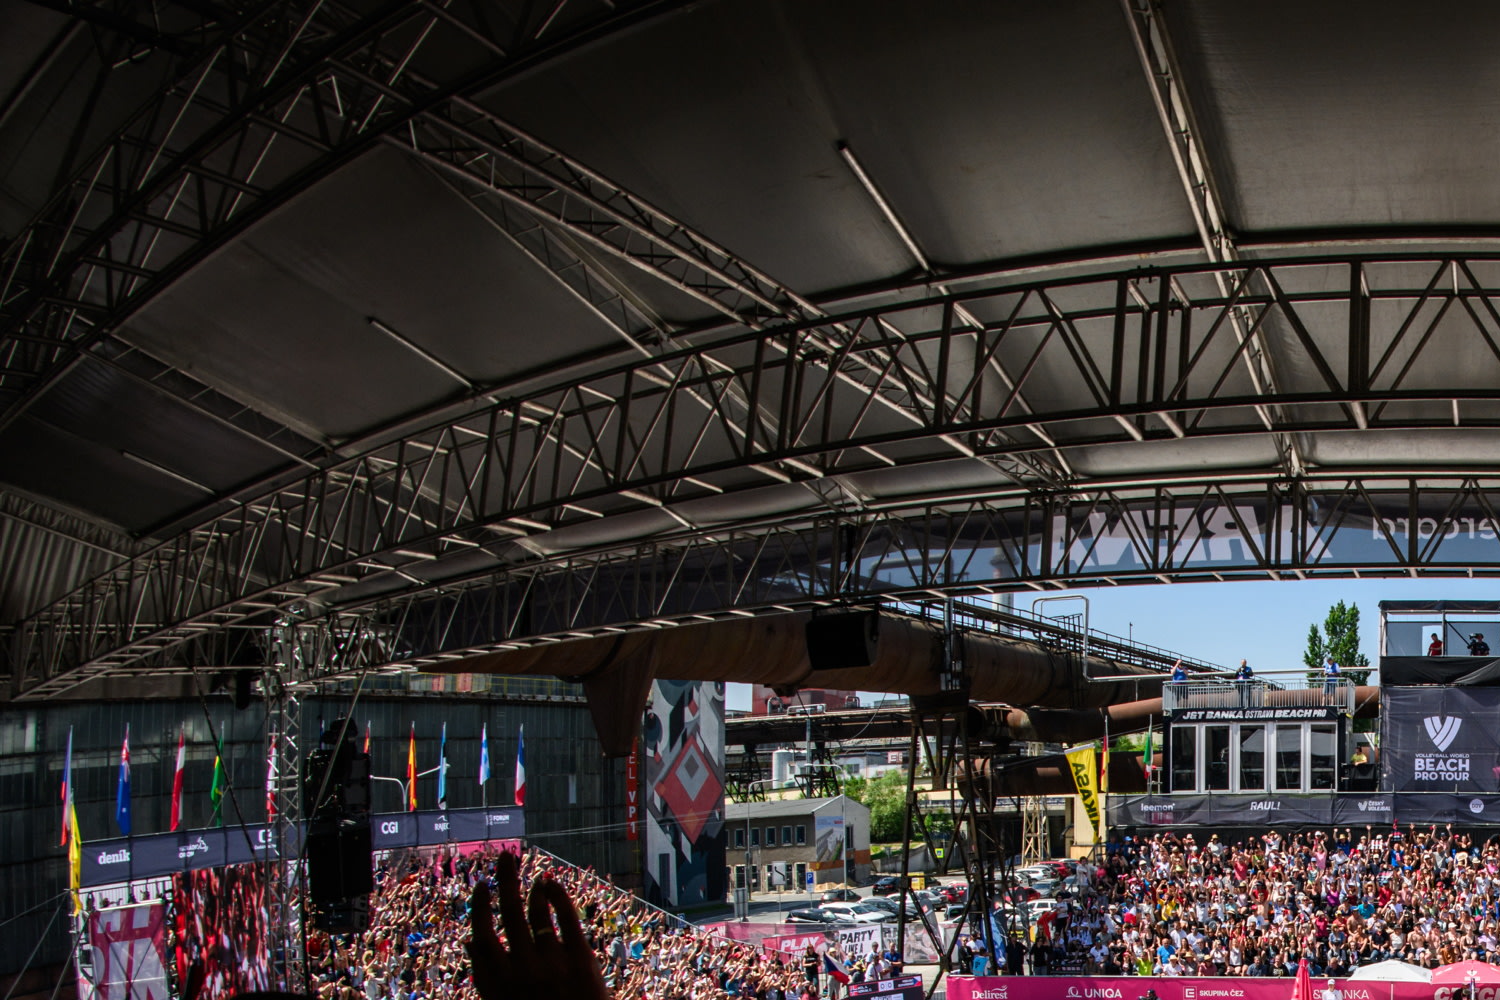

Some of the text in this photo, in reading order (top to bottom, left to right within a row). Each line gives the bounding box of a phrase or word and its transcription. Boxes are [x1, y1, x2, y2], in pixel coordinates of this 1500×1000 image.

[1183, 711, 1205, 719] J&T
[1206, 710, 1243, 719] BANKA
[1275, 709, 1312, 717] BEACH
[1313, 709, 1327, 717] PRO
[1414, 758, 1470, 771] BEACH
[1414, 772, 1470, 781] PRO TOUR
[1250, 801, 1280, 811] RAUL!
[381, 821, 398, 834] CGI
[840, 930, 874, 944] PARTY
[781, 936, 820, 952] PLAY
[972, 988, 1008, 1000] Delirest
[1084, 988, 1122, 999] UNIQA
[1230, 988, 1244, 997] ČEZ
